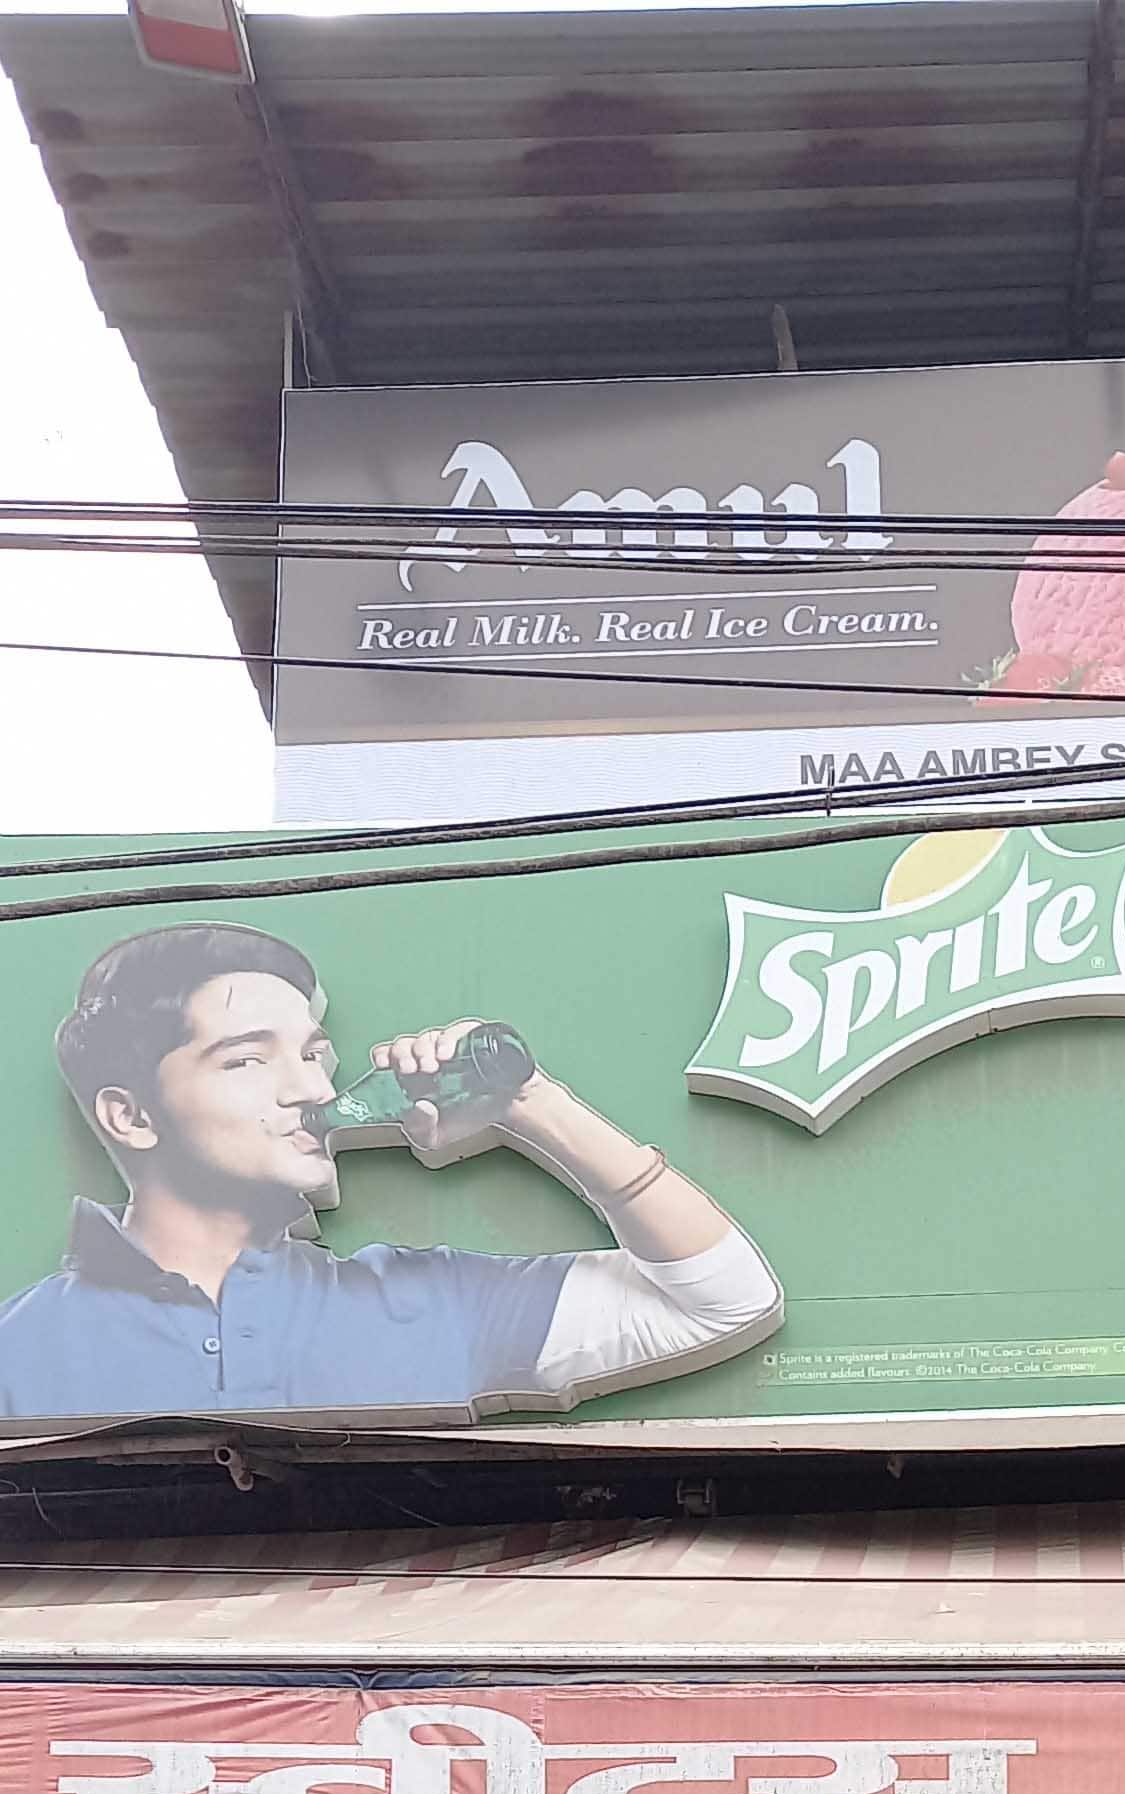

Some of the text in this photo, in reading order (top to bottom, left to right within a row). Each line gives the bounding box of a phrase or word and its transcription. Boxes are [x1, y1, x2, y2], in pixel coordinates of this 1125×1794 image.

[399, 438, 894, 593] Amul
[357, 602, 941, 652] Real Milk. Real Ice Cream.
[800, 749, 905, 785] MAA
[738, 850, 1100, 1075] Sprite
[779, 1352, 812, 1365] Sprite
[834, 1351, 889, 1364] registered
[969, 1346, 991, 1357] The
